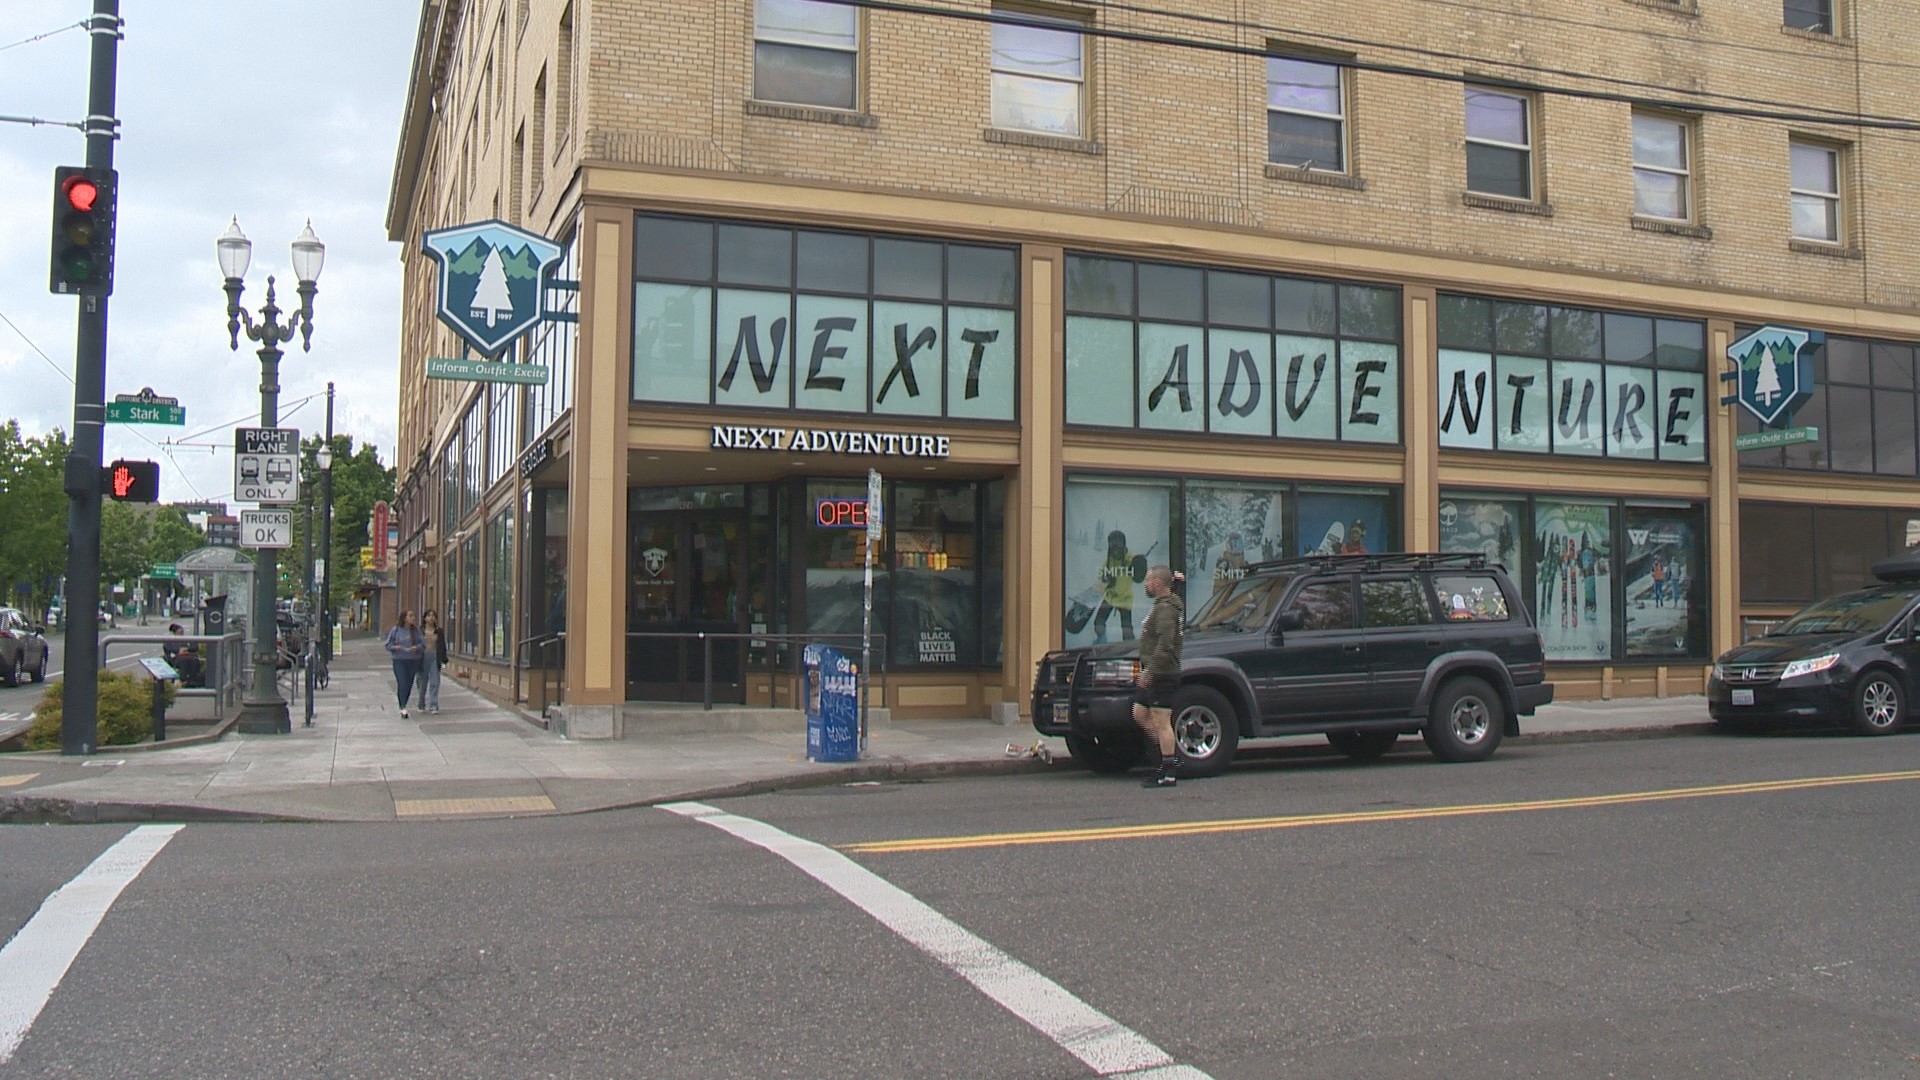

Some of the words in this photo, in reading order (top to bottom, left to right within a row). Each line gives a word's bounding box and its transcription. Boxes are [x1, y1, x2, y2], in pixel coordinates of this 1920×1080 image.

[470, 310, 487, 319] EST.
[497, 312, 513, 320] 1997
[718, 314, 999, 405] NEXT
[431, 361, 469, 374] Inform
[475, 364, 507, 377] Outfit
[514, 367, 547, 378] Excite
[110, 409, 120, 418] SE
[129, 407, 160, 421] Stark
[245, 430, 291, 442] RIGHT
[712, 425, 786, 449] NEXT
[790, 429, 950, 457] ADVENTURE
[246, 442, 288, 453] LANE
[245, 488, 288, 499] ONLY
[244, 513, 289, 525] TRUCKS
[819, 501, 870, 525] OPE
[255, 528, 277, 543] OK
[1097, 566, 1135, 577] SMITH
[920, 631, 951, 640] BLACK
[923, 642, 951, 651] LIVES
[919, 653, 957, 662] MATTER
